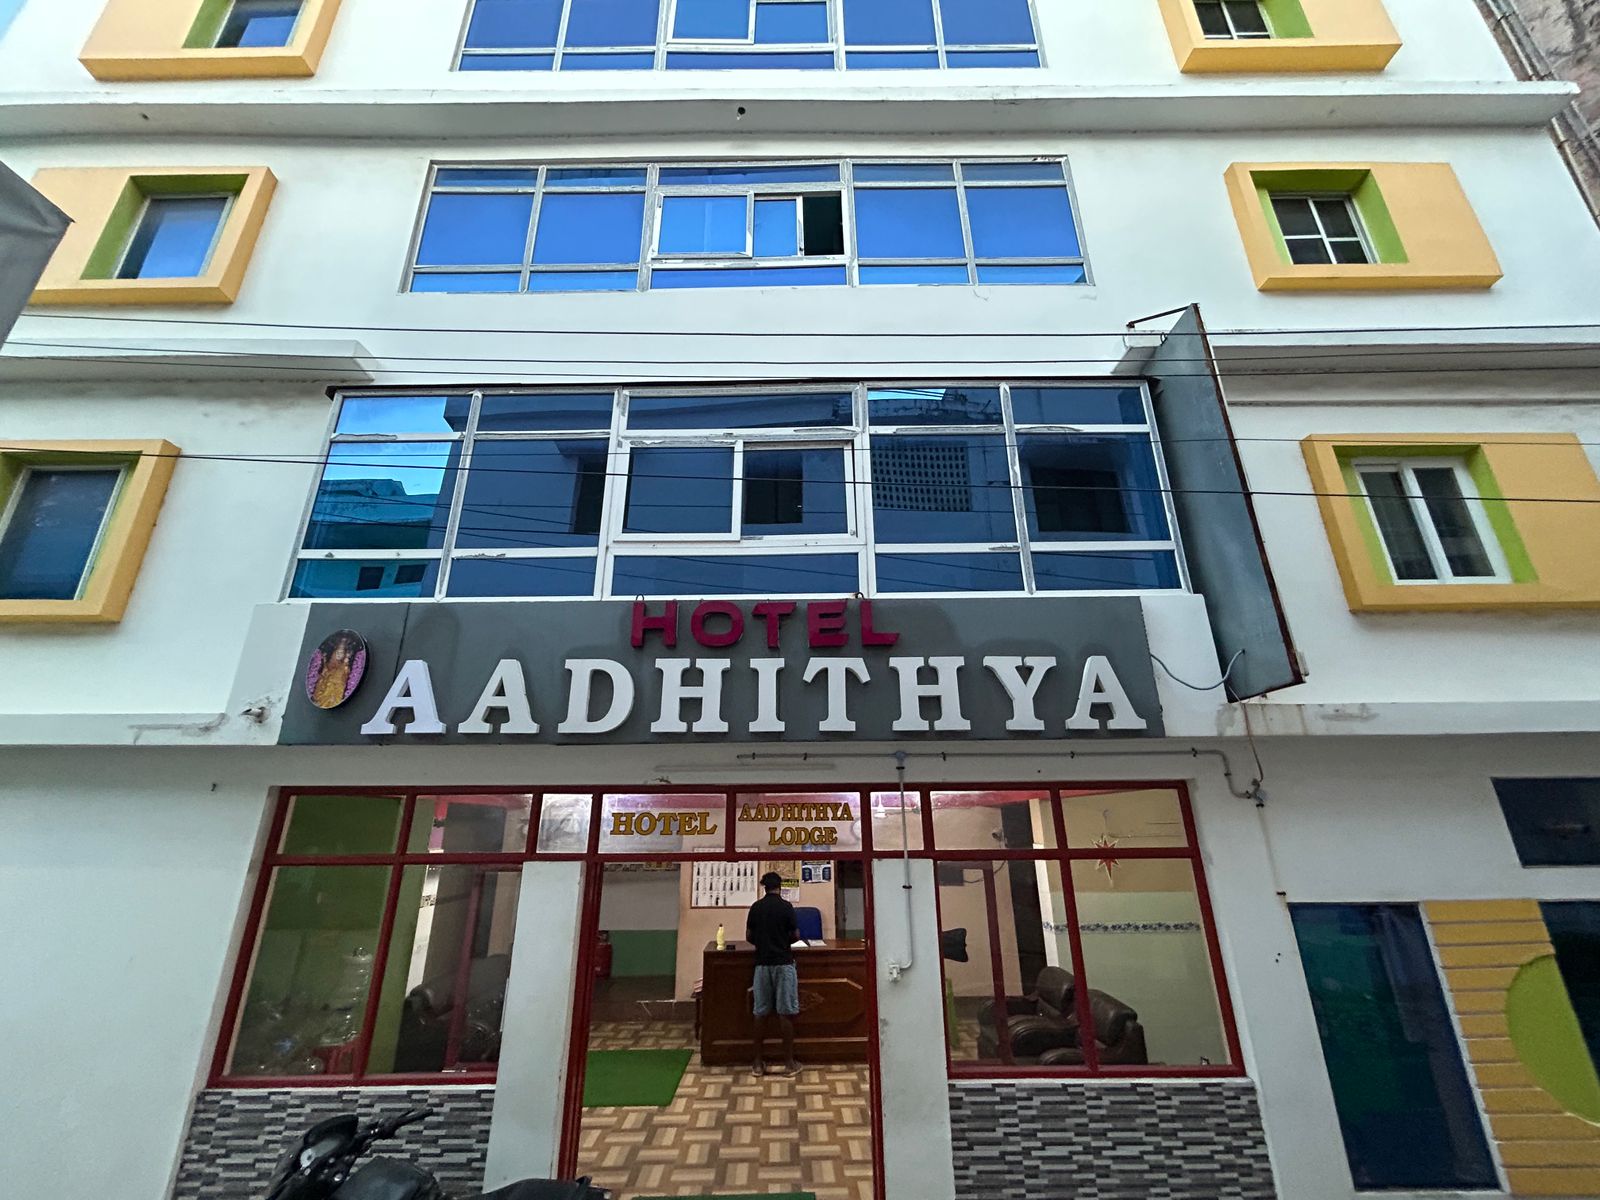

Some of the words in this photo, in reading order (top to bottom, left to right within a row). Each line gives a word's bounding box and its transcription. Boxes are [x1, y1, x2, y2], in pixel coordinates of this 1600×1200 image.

[631, 599, 900, 648] HOTEL
[361, 656, 1147, 736] AADHITHYA
[611, 813, 717, 835] HOTEL
[739, 804, 853, 822] AADHITHYA
[769, 828, 837, 846] LODGE
